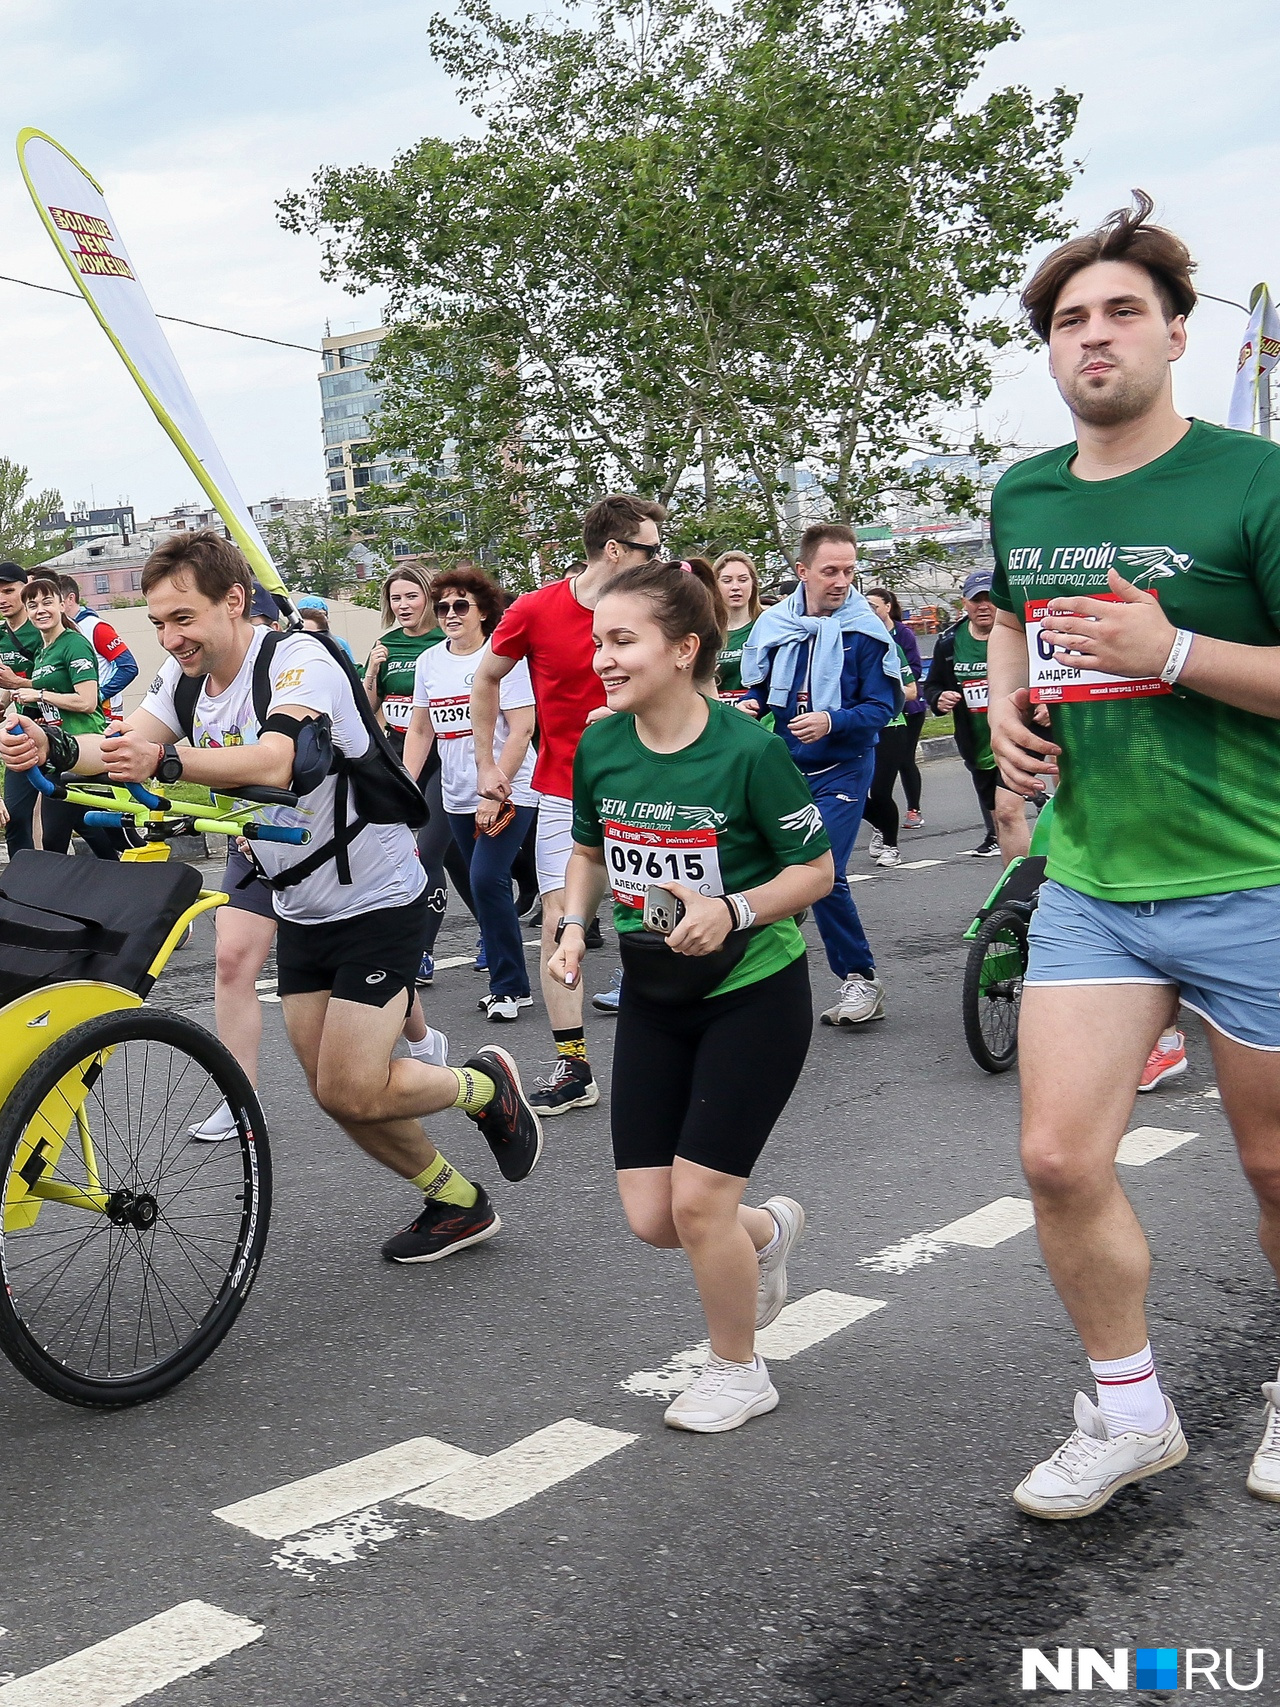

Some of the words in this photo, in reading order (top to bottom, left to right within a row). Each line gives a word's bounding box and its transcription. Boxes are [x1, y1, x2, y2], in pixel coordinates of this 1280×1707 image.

[51, 208, 112, 240] БОЛЬШЕ
[74, 231, 110, 254] ЧЕМ
[1008, 547, 1043, 573] БЕГИ,
[1049, 541, 1118, 571] ГЕРОЙ!
[1036, 574, 1086, 587] НОВГОРОД
[631, 801, 677, 821] ГЕРОЙ!
[610, 846, 705, 880] 09615
[242, 1140, 260, 1260] FELGEBIETER
